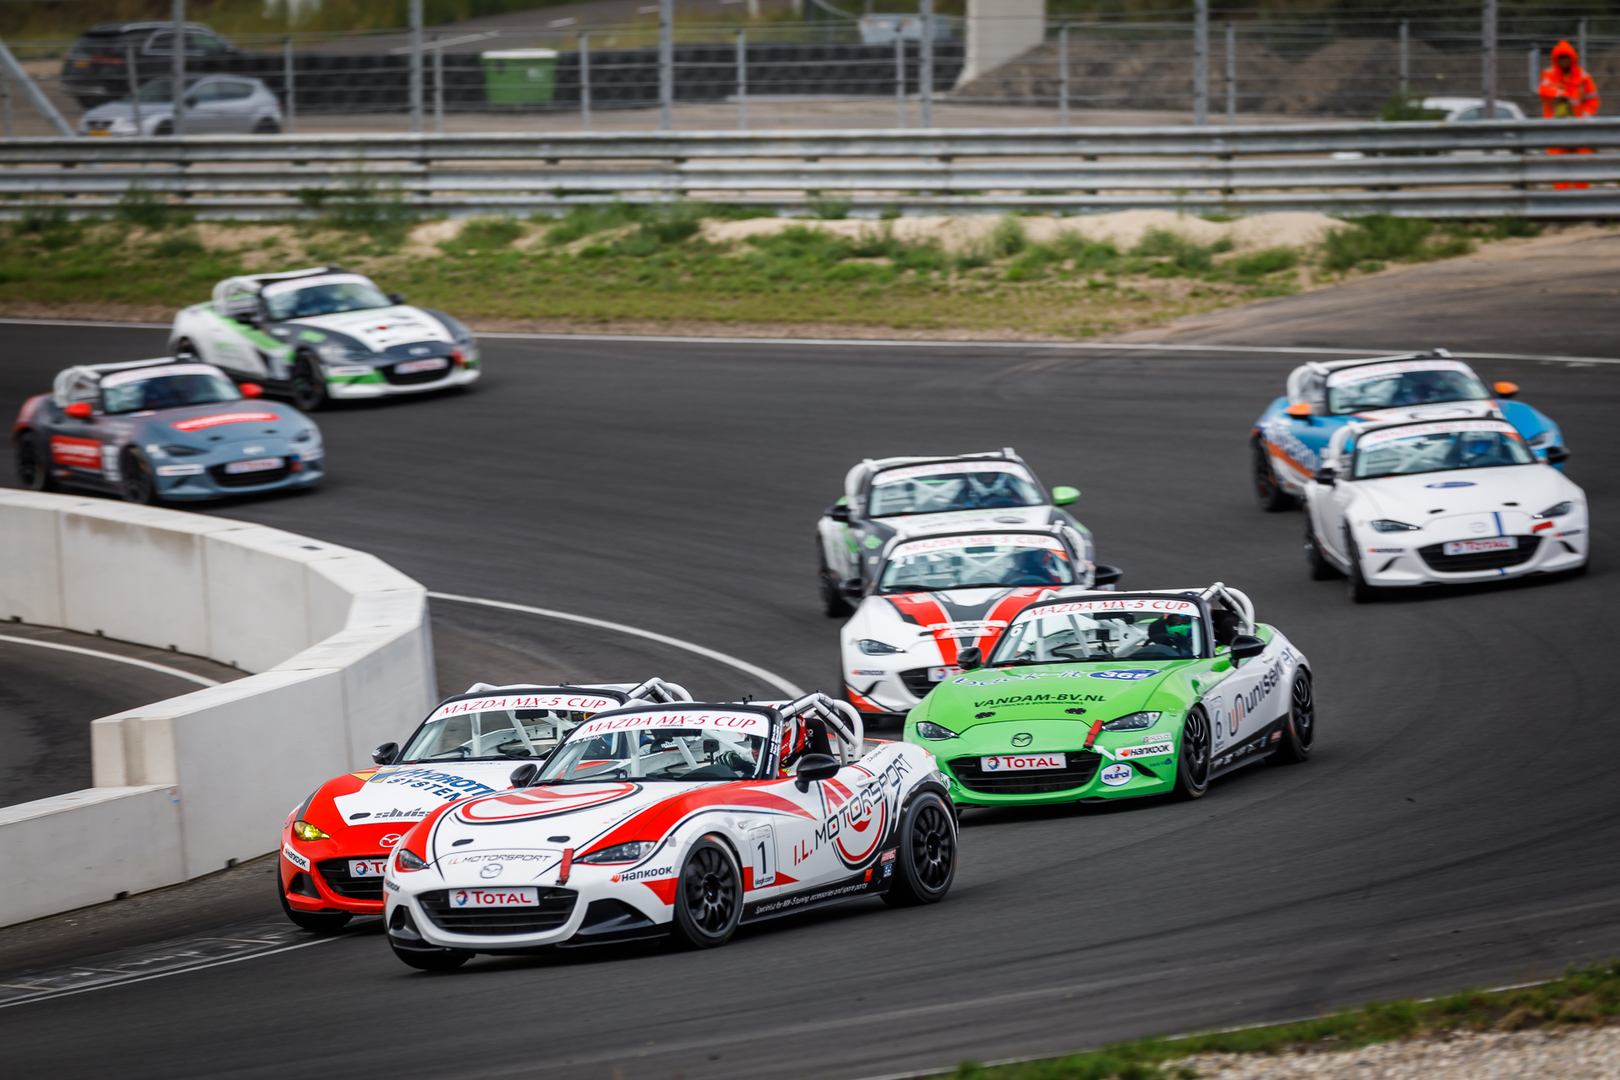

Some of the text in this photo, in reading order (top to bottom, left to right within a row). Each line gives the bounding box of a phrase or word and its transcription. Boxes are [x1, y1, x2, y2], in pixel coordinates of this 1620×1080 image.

[1028, 600, 1190, 617] MAZDA MX-5 CUP
[1009, 624, 1024, 638] 6
[439, 697, 607, 717] MAZDA MX-5 CUP
[973, 693, 1107, 708] VANDAM-BV.NL
[583, 715, 757, 735] MAZDA MX-5 CUP
[1215, 709, 1223, 740] 6
[1003, 757, 1060, 769] TOTAL
[794, 753, 913, 867] I.L. MOTORSPORT
[461, 854, 552, 864] MOTORSPORT
[757, 840, 767, 875] 1
[471, 890, 532, 905] TOTAL
